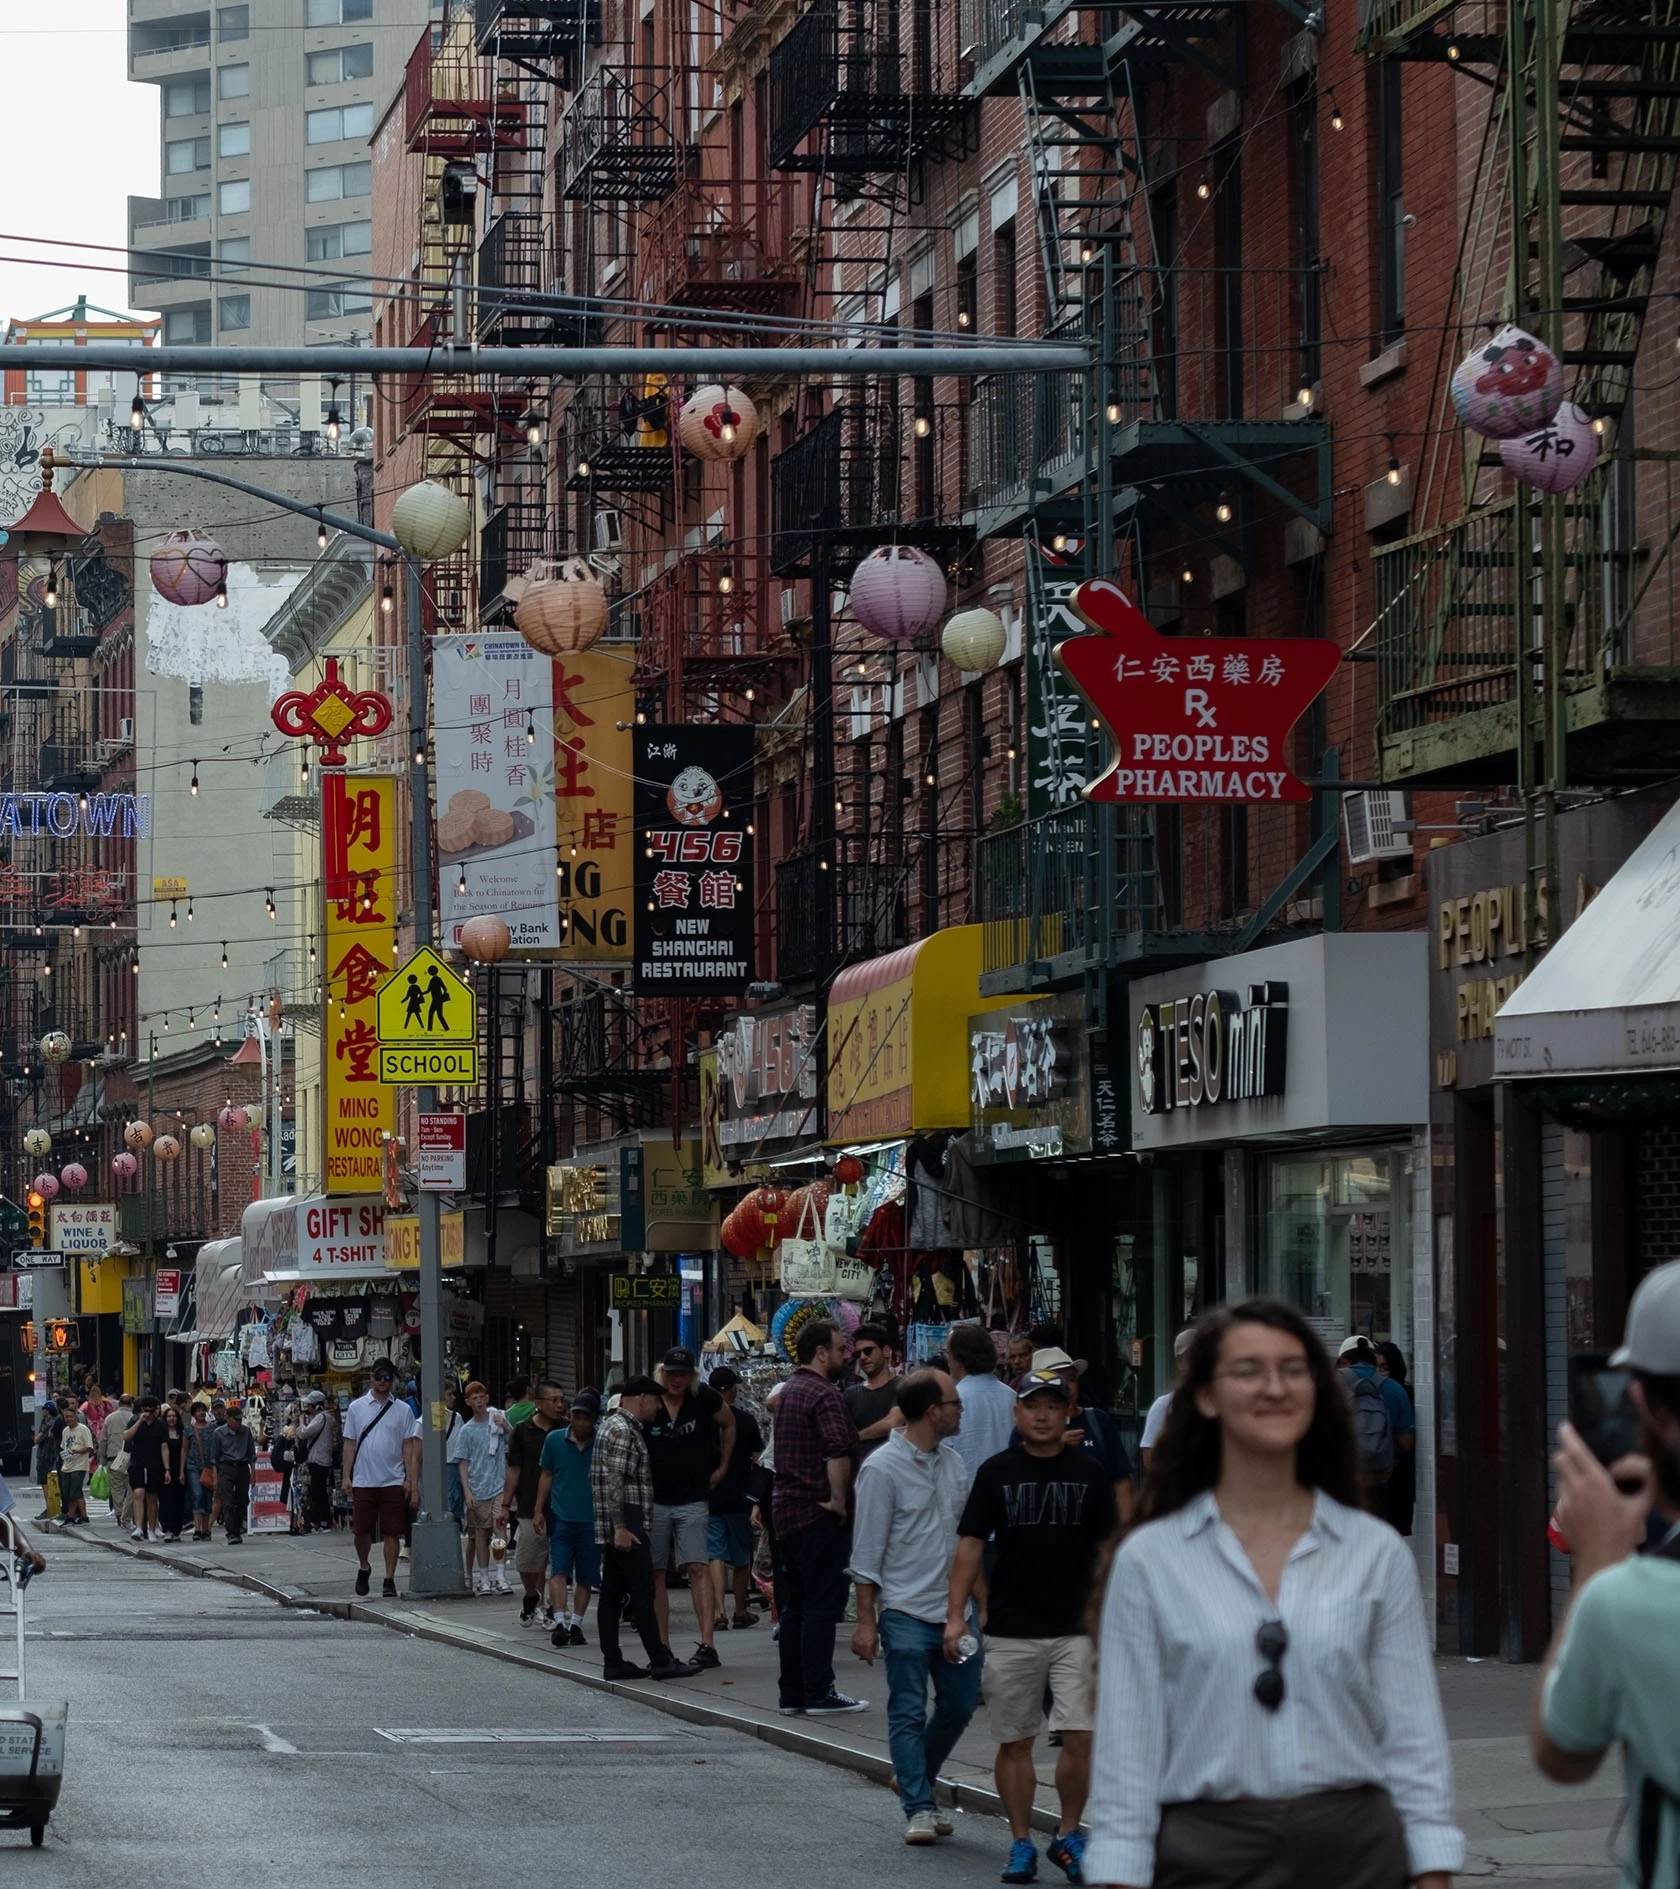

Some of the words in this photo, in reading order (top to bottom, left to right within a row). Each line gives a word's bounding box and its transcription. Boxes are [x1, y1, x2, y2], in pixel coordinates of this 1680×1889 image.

[1112, 652, 1286, 687] 仁安西藥房
[470, 693, 493, 774] 團聚時
[503, 679, 527, 787] 月圓桂香
[1133, 733, 1270, 763] PEOPLES
[1115, 768, 1287, 799] PHARMACY
[582, 808, 618, 850] 店
[651, 831, 743, 863] 456
[479, 875, 519, 884] Welcome
[453, 889, 473, 898] Back
[486, 888, 531, 897] Chinatown
[533, 888, 544, 896] for
[652, 870, 737, 909] 餐館
[453, 902, 466, 911] the
[469, 902, 498, 911] Season
[499, 901, 508, 910] of
[520, 923, 549, 934] Bank
[675, 919, 710, 935] NEW
[510, 934, 540, 945] ation
[652, 940, 734, 957] SHANGHAI
[641, 961, 748, 979] RESTAURANT
[1160, 989, 1223, 1110] TESO
[1228, 982, 1270, 1100] mini
[385, 1055, 470, 1075] SCHOOL
[339, 1097, 379, 1119] MING
[1095, 1080, 1119, 1147] 天仁茗茶
[420, 1116, 429, 1125] NO
[430, 1116, 457, 1125] STANDING
[335, 1127, 382, 1148] WONG
[328, 1156, 382, 1177] RESTAURA
[430, 1155, 455, 1163] PARKING
[421, 1164, 444, 1173] Anytime
[55, 1210, 113, 1224] 太白酒莊
[307, 1206, 352, 1239] GIFT
[63, 1228, 93, 1238] WINE
[97, 1228, 105, 1237] &
[60, 1239, 108, 1249] LIQUOR
[41, 1255, 58, 1263] WAY
[312, 1247, 322, 1263] 4
[328, 1245, 378, 1264] T-SHIT
[841, 1268, 861, 1280] CITY
[8, 1736, 48, 1745] STATS
[8, 1746, 53, 1756] SERVCE
